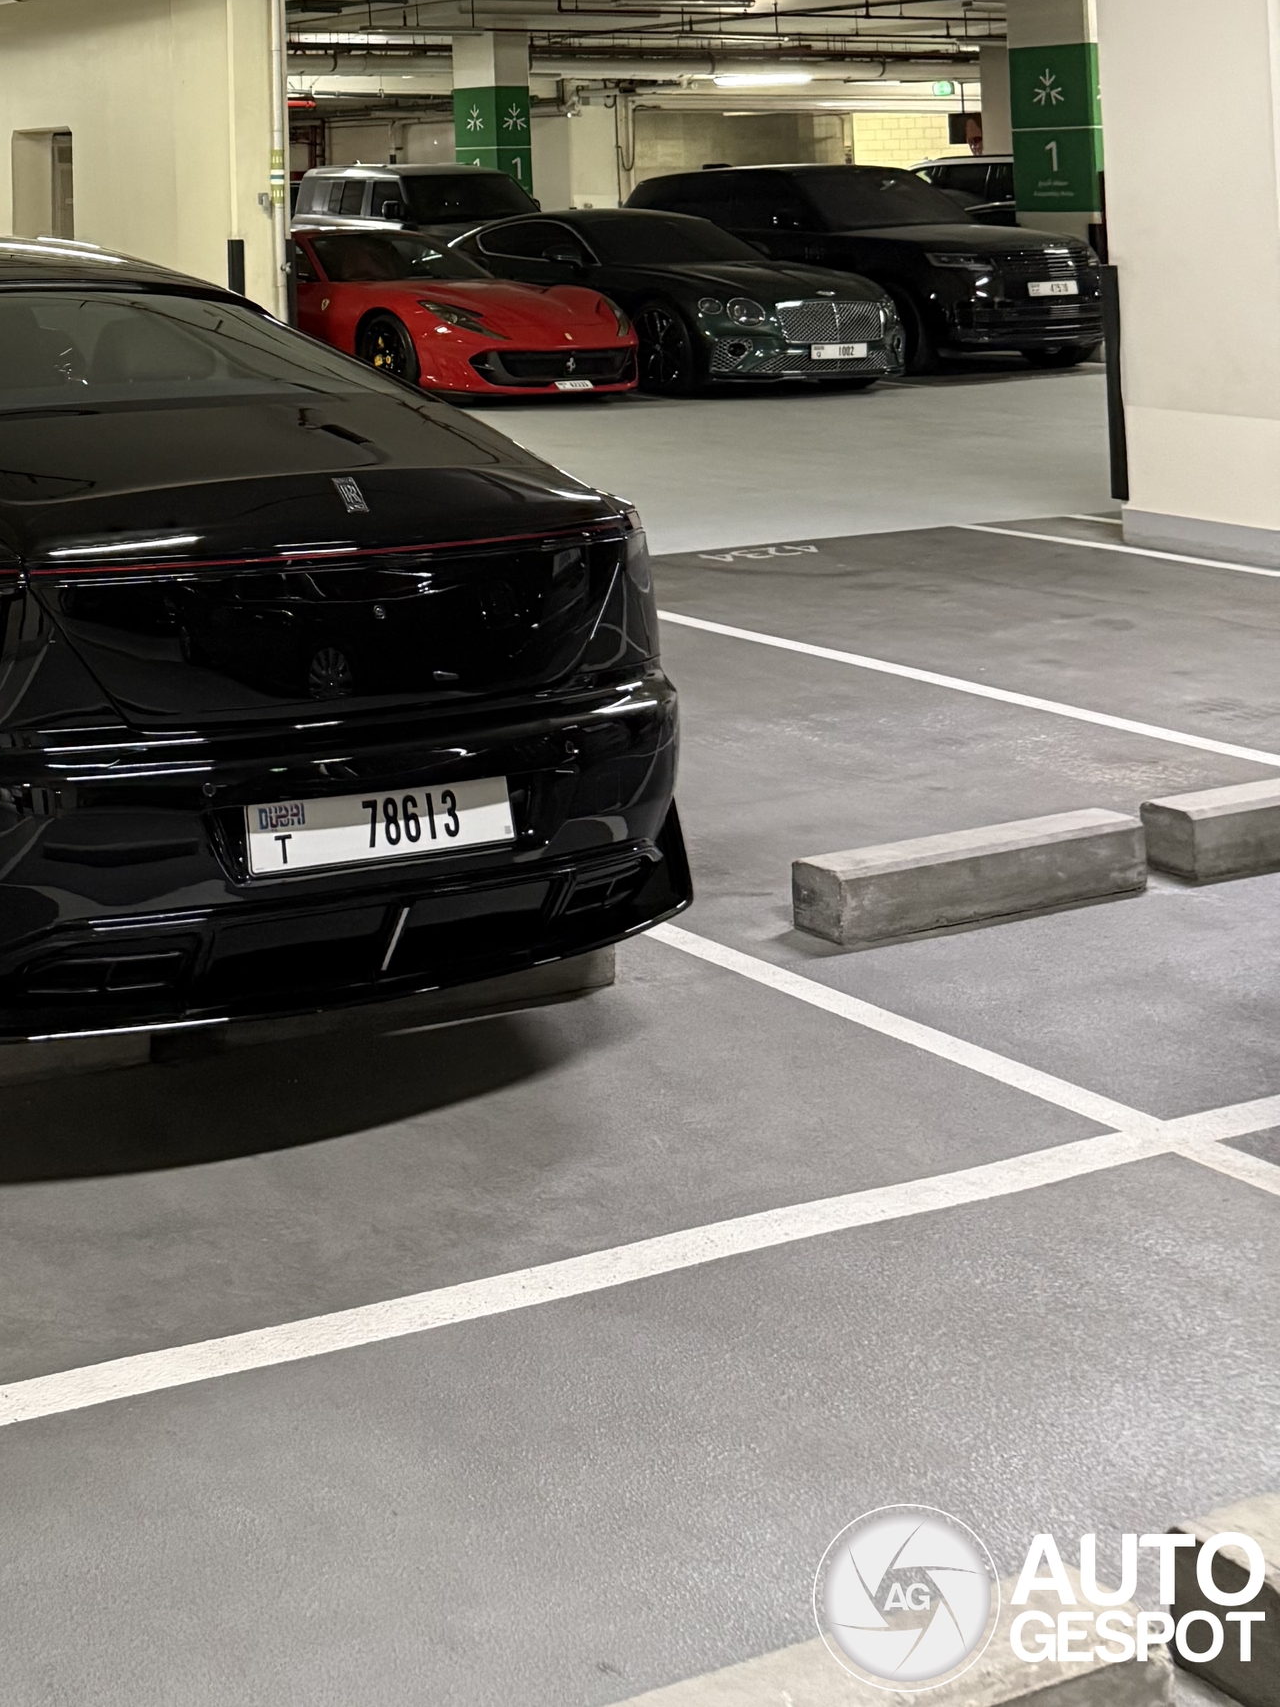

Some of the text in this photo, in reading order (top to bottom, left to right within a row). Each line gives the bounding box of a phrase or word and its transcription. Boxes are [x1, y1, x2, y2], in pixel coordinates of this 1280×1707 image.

[511, 157, 522, 180] 1
[1045, 141, 1058, 172] 1
[361, 789, 460, 849] 78613
[274, 833, 293, 865] T
